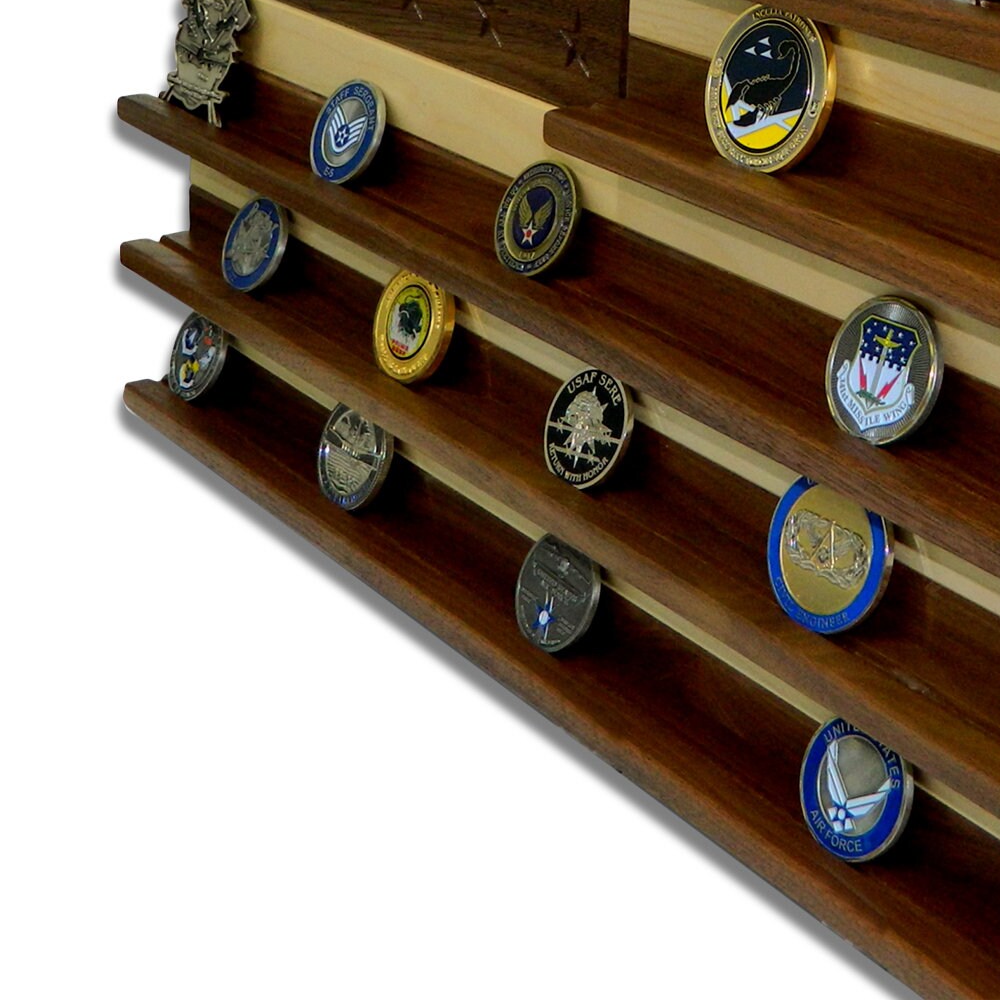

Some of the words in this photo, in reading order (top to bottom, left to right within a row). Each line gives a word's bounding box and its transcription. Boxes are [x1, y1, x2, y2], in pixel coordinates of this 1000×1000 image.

[326, 87, 350, 113] STAFF
[353, 86, 376, 131] SERGEANT
[567, 371, 598, 394] USAF
[598, 374, 622, 406] SERE
[847, 399, 881, 426] MISSILE
[882, 402, 908, 422] WING
[582, 457, 609, 481] HONOR
[796, 611, 851, 628] ENGINEER
[824, 722, 860, 742] UNIT
[878, 743, 900, 789] ATES
[810, 809, 826, 833] AIR
[824, 831, 863, 852] FORCE
